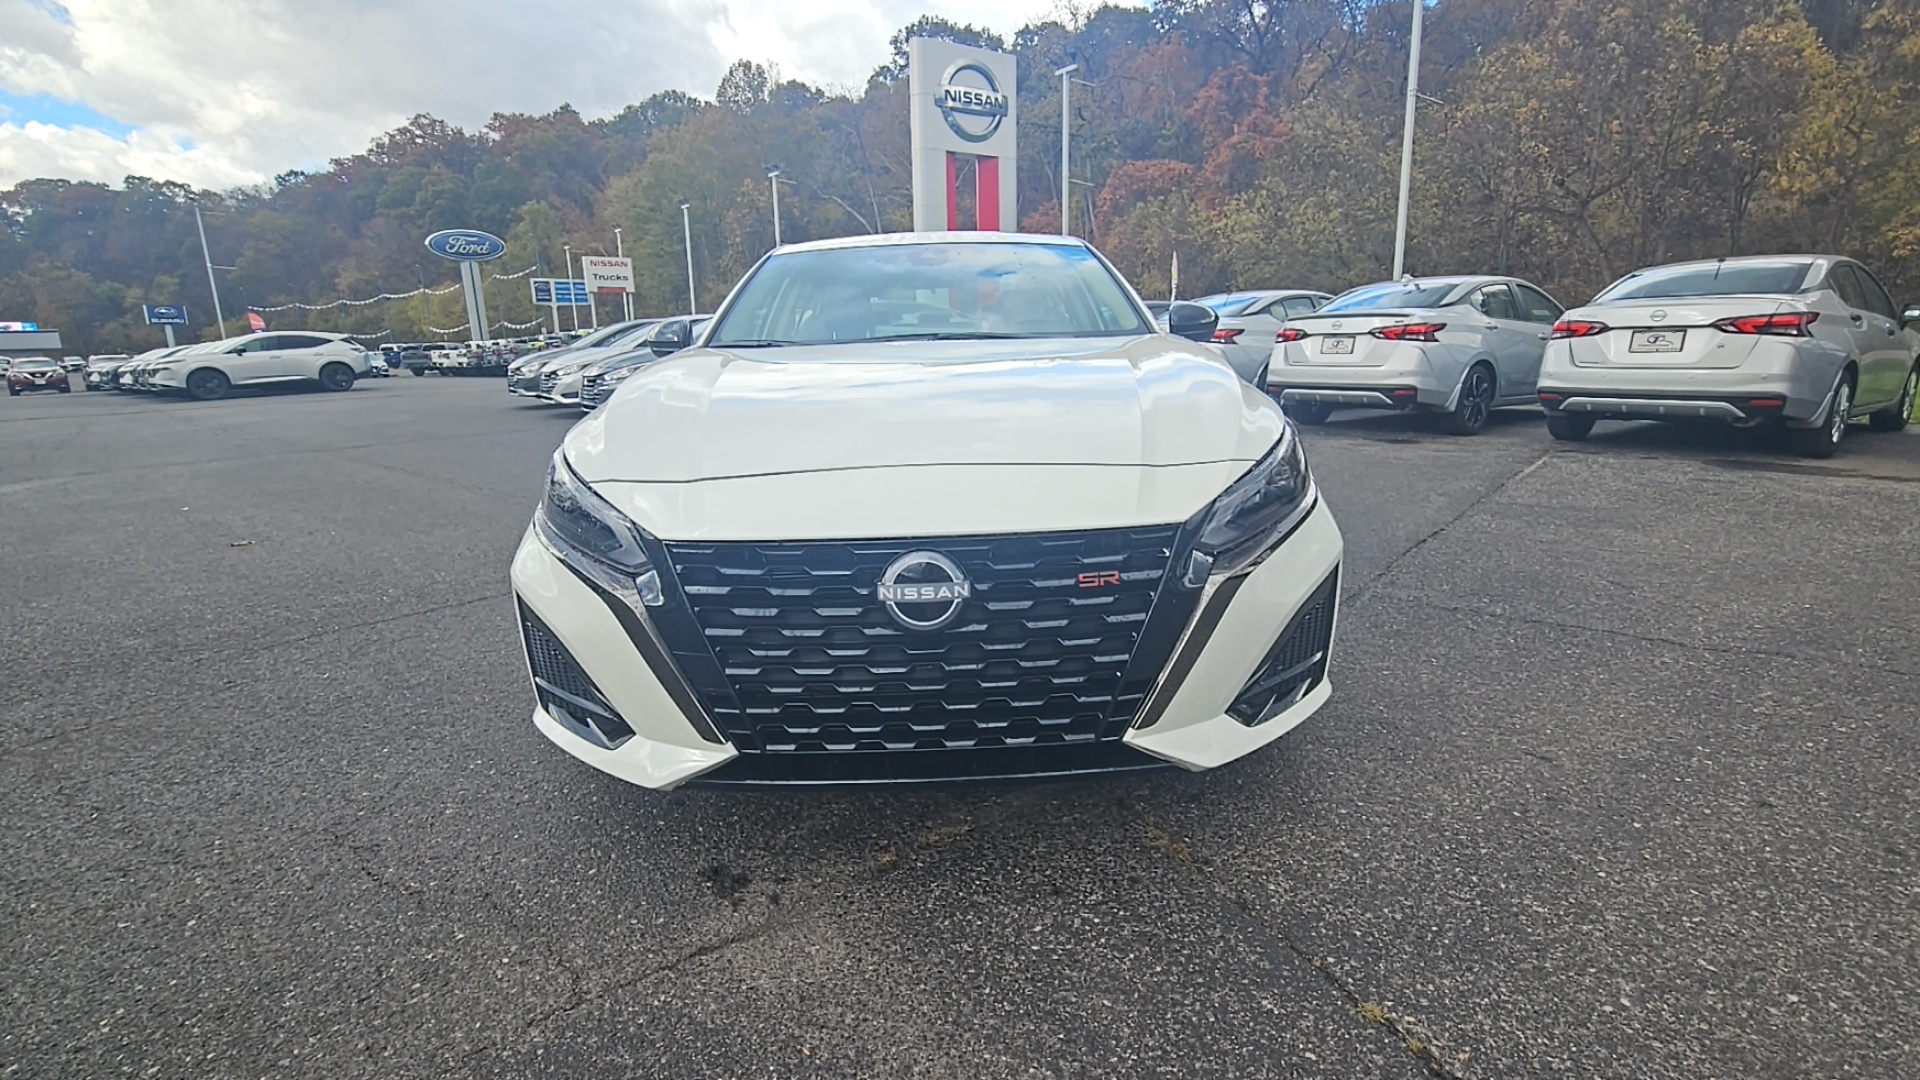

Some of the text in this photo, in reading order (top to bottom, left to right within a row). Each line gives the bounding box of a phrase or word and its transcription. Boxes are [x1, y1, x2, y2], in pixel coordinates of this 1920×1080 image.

[944, 89, 1004, 109] NISSAN
[445, 236, 490, 254] Ford
[589, 260, 628, 268] NISSAN
[592, 273, 629, 282] Trucks
[1078, 571, 1121, 587] SR
[879, 584, 969, 600] NISSAN
